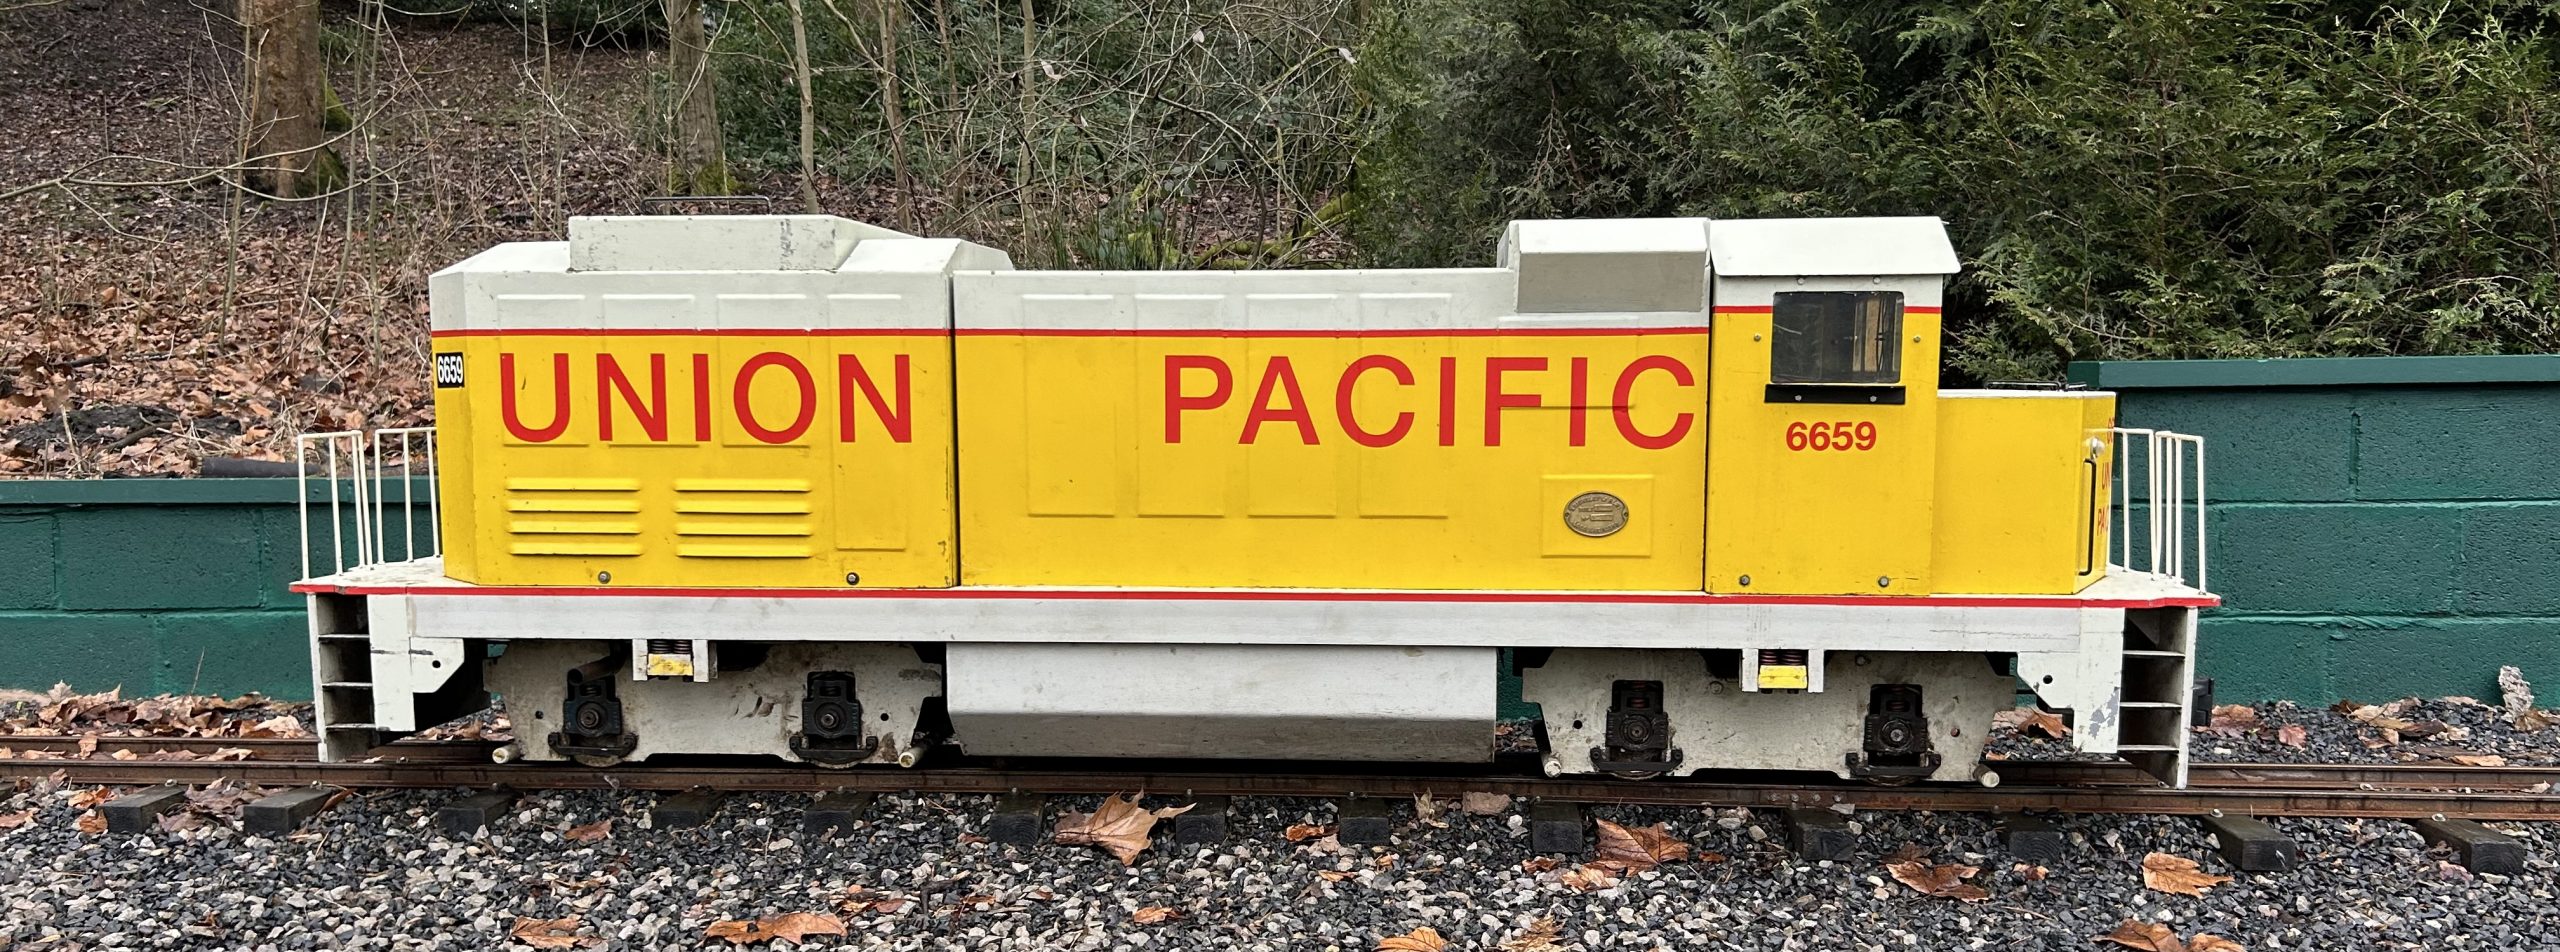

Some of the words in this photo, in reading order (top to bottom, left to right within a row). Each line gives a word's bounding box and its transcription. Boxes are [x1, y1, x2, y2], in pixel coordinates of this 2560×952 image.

[437, 355, 464, 384] 6659
[500, 351, 912, 448] UNION
[1164, 354, 1695, 450] PACIFIC
[1786, 421, 1877, 452] 6659
